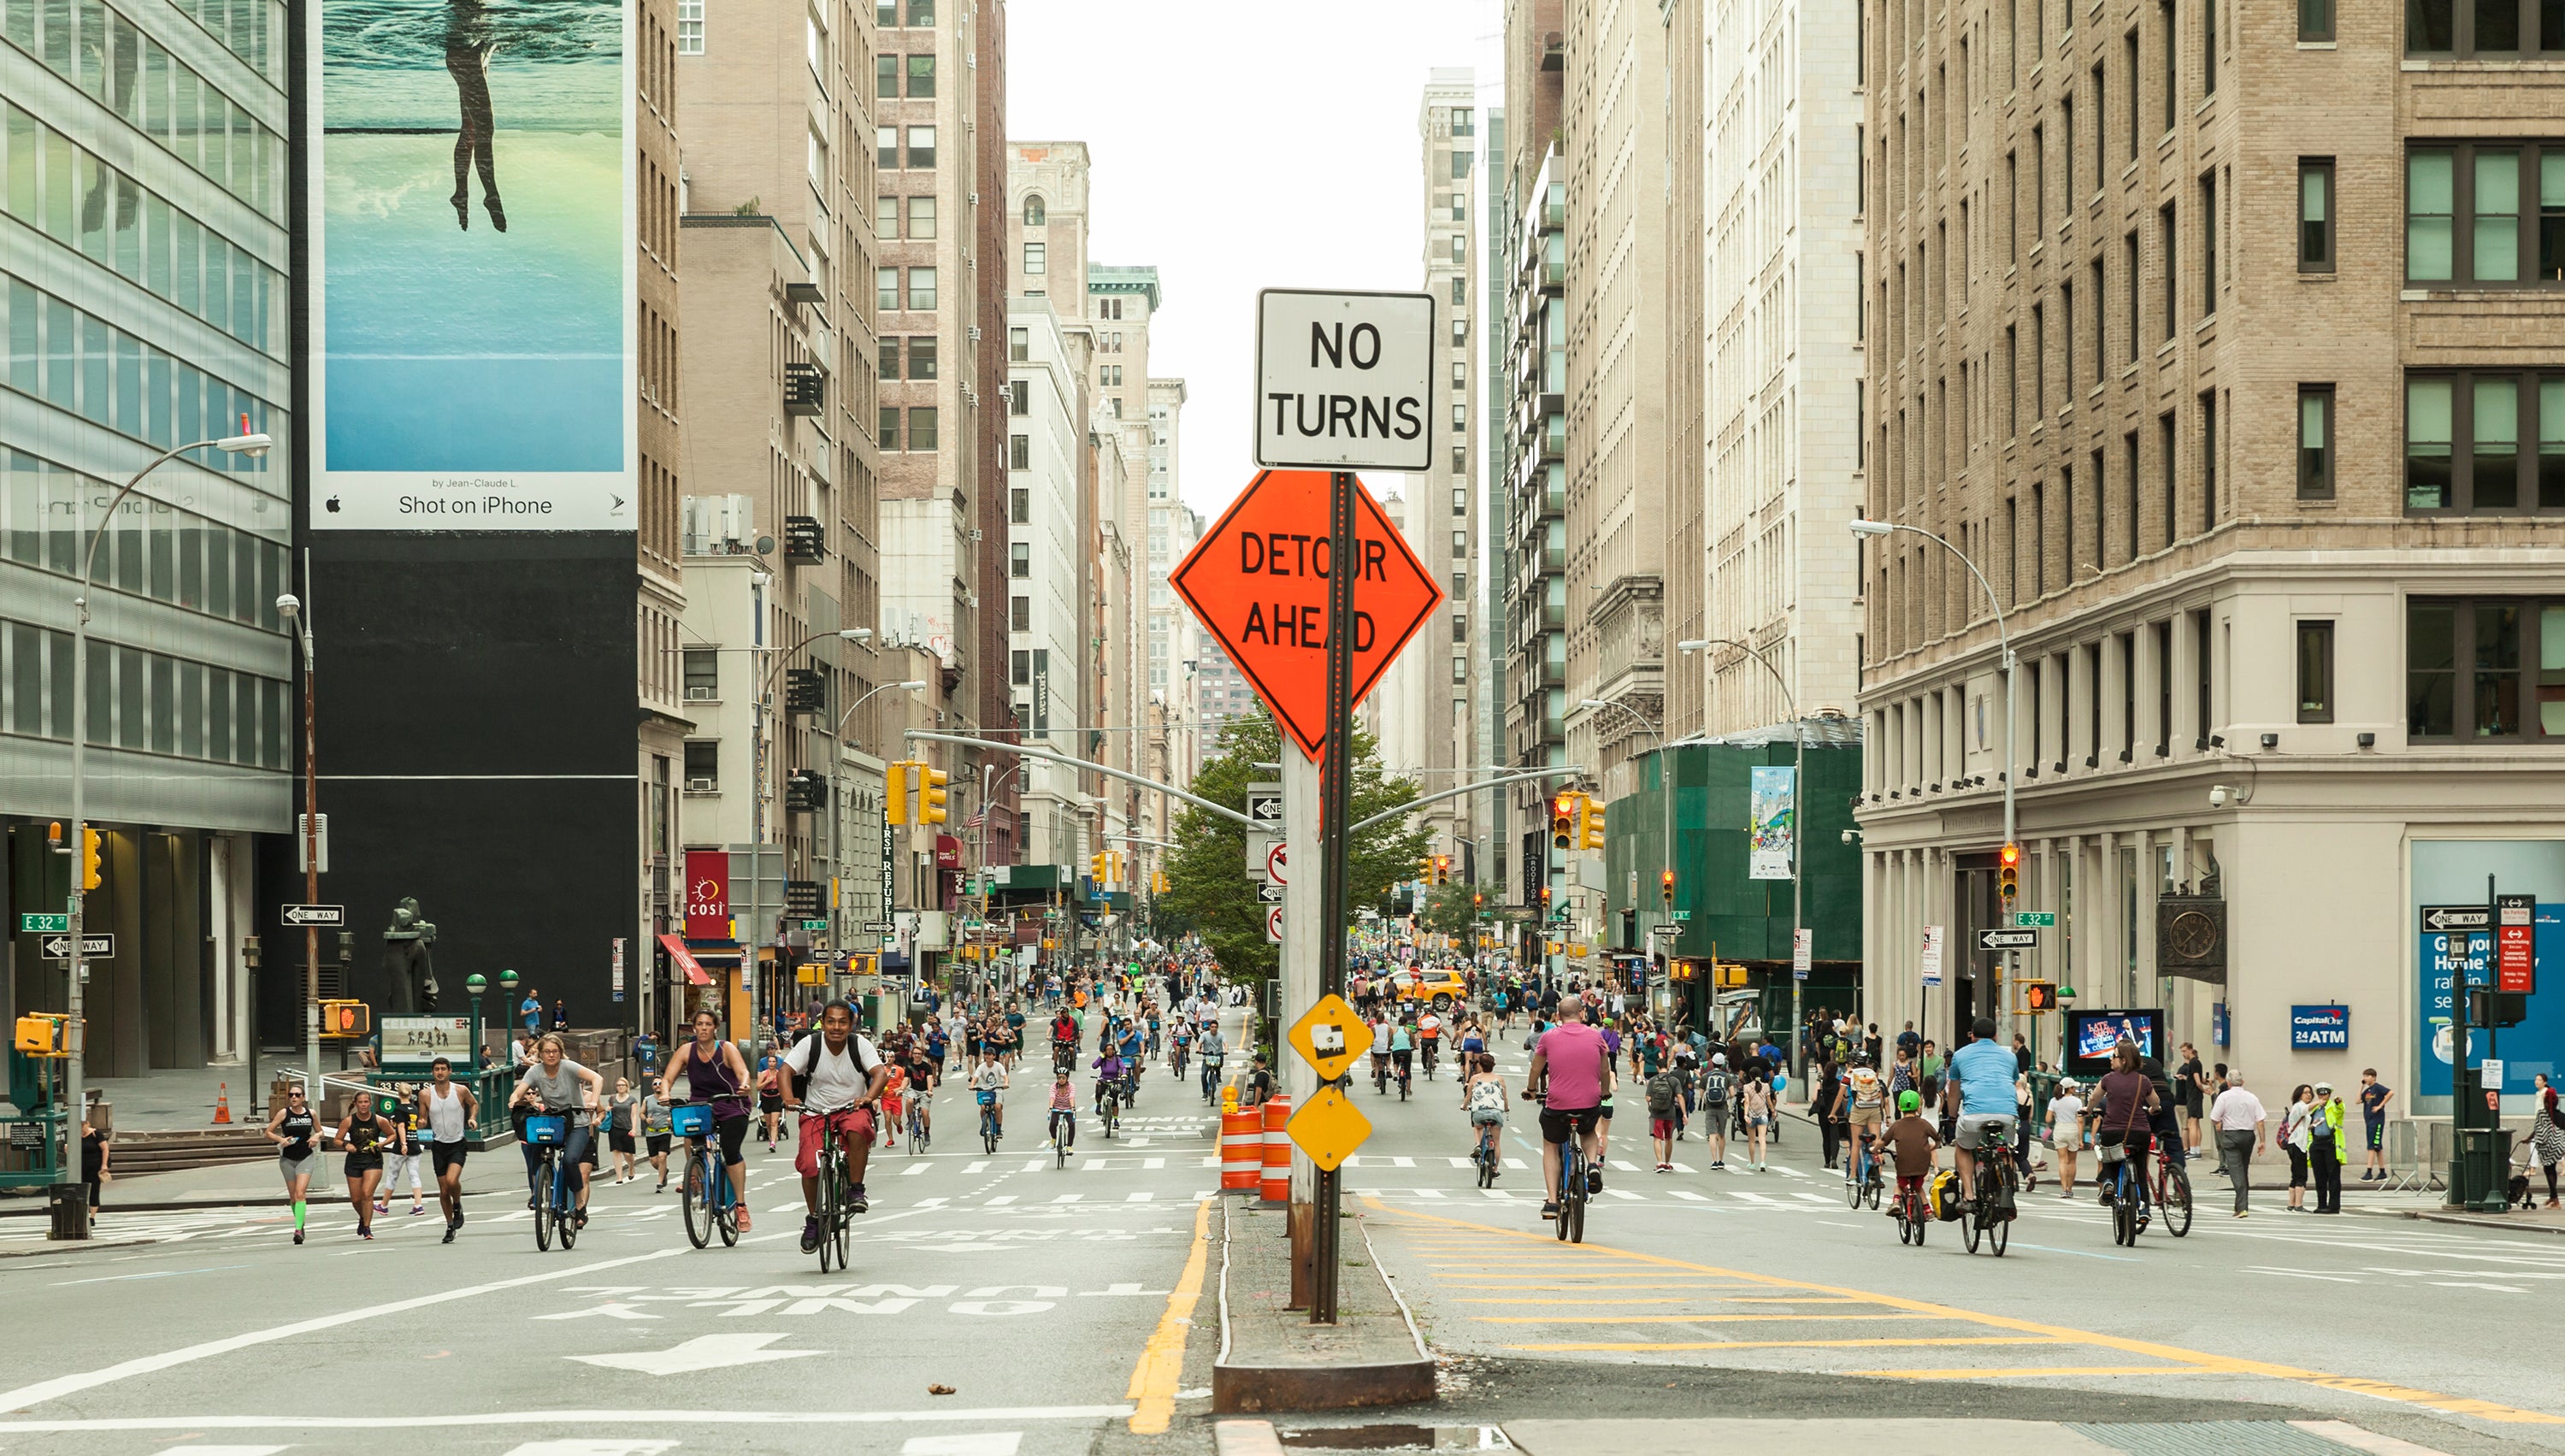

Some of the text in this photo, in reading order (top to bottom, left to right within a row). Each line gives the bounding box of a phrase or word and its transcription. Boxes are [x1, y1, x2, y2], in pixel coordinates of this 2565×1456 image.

[1311, 321, 1381, 370] NO
[1268, 392, 1422, 440] TURNS
[432, 479, 519, 488] by Jean-Claude L.
[398, 496, 552, 514] Shot on iPhone
[1241, 602, 1376, 652] AHED
[1035, 669, 1047, 717] wework
[1263, 804, 1282, 813] ONE
[883, 861, 893, 922] REPUBLI
[292, 911, 335, 919] ONE WAY
[2018, 914, 2024, 924] E
[2028, 914, 2041, 925] 32
[2435, 915, 2483, 923] ONE WAY
[26, 917, 33, 928] E
[38, 917, 53, 929] 32
[53, 942, 103, 952] ONE WAY
[2087, 1021, 2108, 1032] LATE
[2296, 1031, 2345, 1043] 24 ATM
[646, 1051, 652, 1060] P
[384, 1101, 391, 1110] 6
